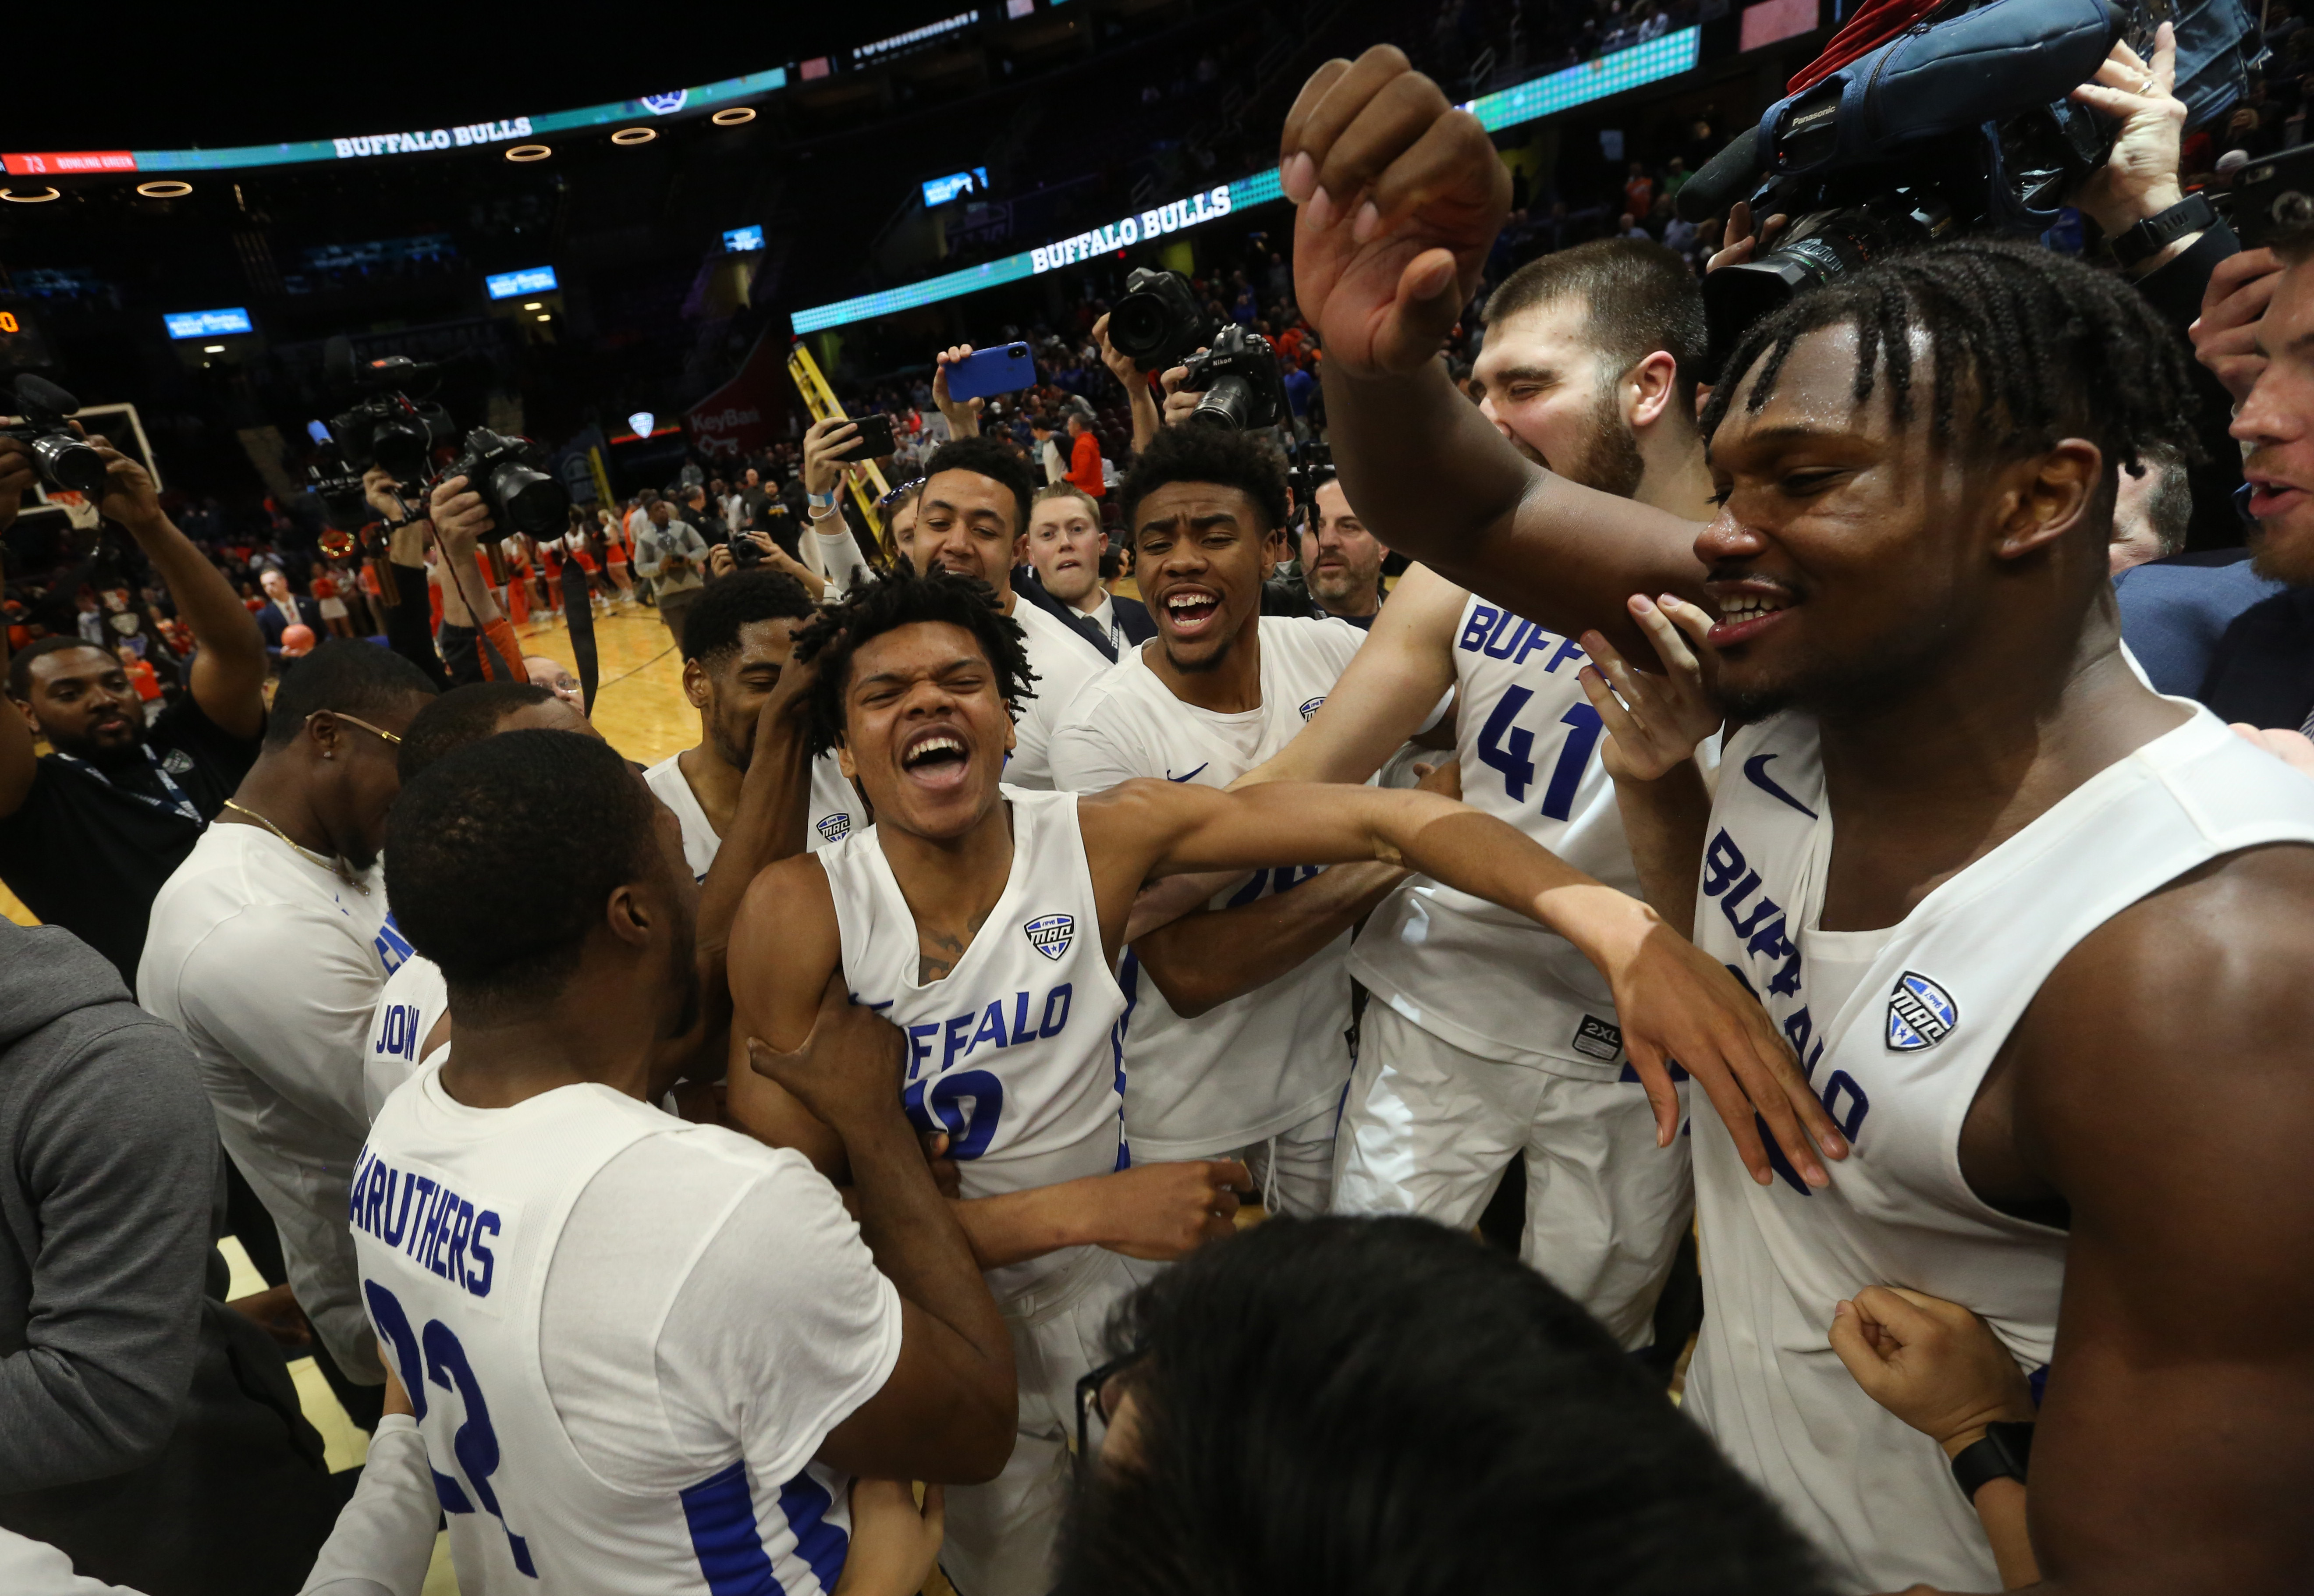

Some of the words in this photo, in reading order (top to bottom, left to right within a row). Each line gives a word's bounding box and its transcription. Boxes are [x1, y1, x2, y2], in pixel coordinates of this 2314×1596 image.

[1792, 105, 1836, 127] Panasonic
[333, 129, 451, 158] BUFFALO
[453, 117, 533, 147] BULLS
[23, 155, 46, 173] 73
[1030, 217, 1139, 274] BUFFALO
[1141, 185, 1232, 240] BULLS
[1129, 280, 1145, 293] Canon
[1213, 358, 1232, 366] Nikon
[1478, 684, 1604, 821] 41
[821, 820, 851, 837] MAC
[1030, 925, 1074, 944] MAC
[1703, 826, 1870, 1144] BUFFAO
[1924, 992, 1943, 1009] 1946
[1889, 987, 1947, 1045] MAC
[904, 982, 1073, 1080] FFALO
[1585, 1022, 1618, 1043] 2XL
